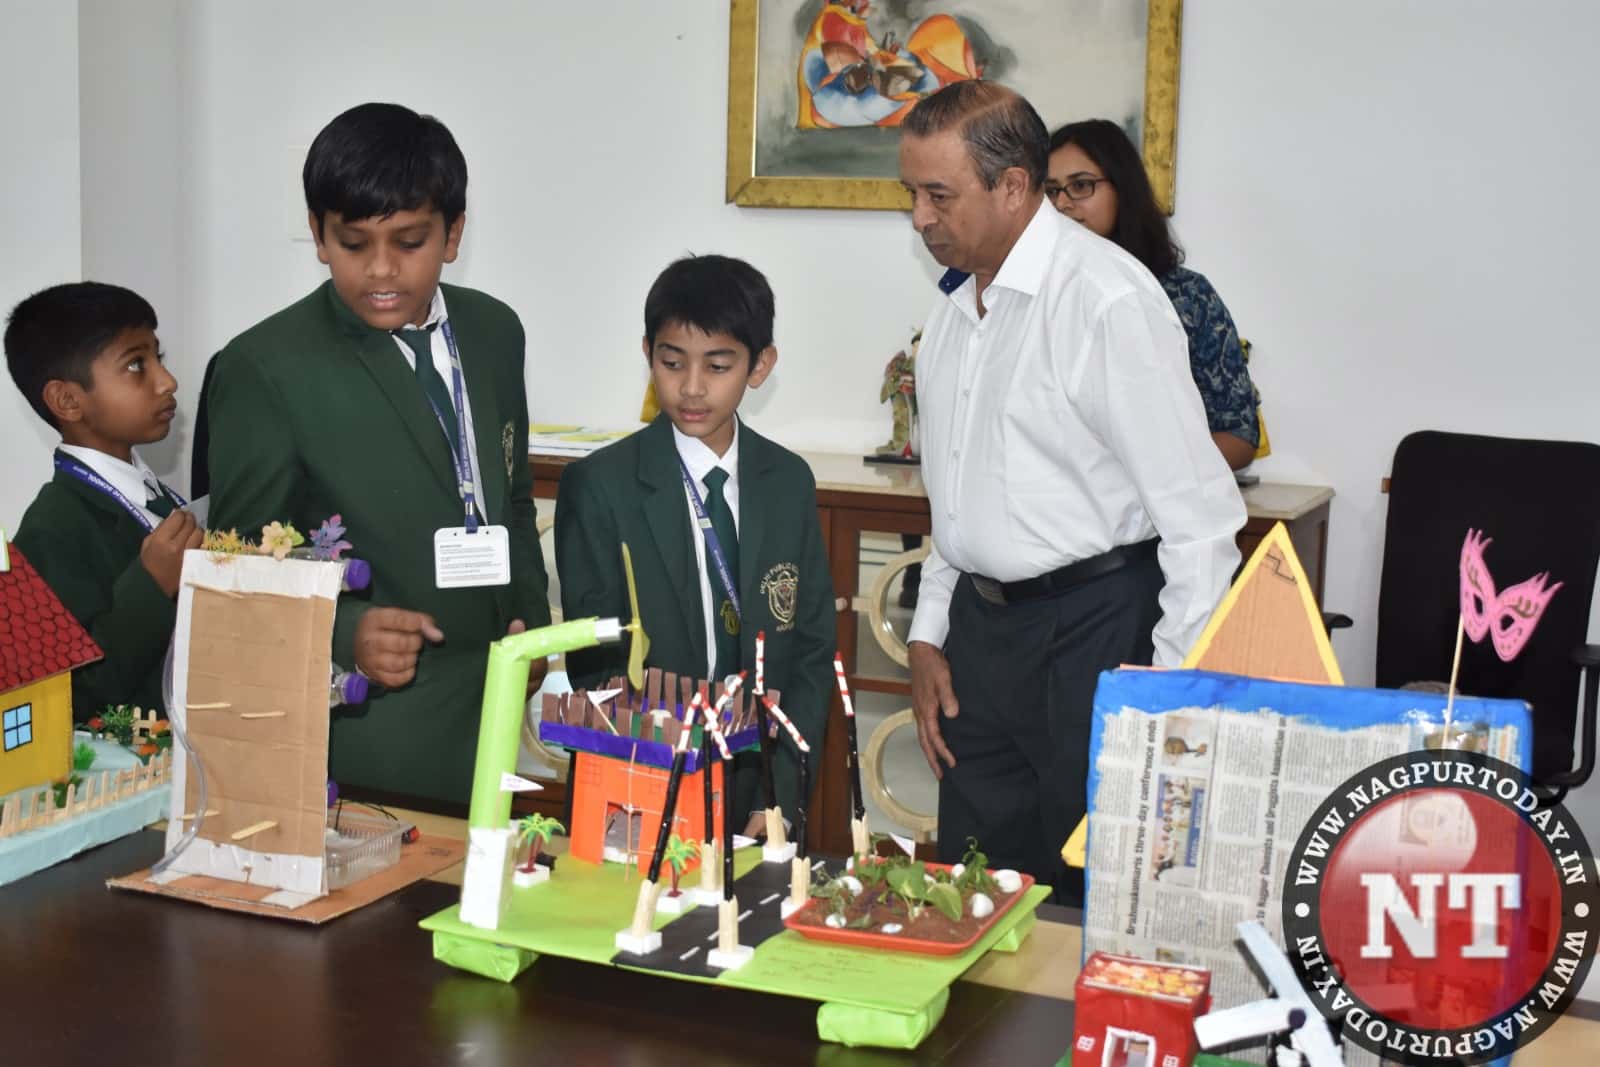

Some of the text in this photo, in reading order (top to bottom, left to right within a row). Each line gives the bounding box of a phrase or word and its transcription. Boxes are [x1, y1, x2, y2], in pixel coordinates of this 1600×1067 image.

[87, 473, 114, 493] SCHOOL
[1270, 730, 1285, 776] Association
[1265, 779, 1279, 817] Druggists
[1126, 720, 1157, 936] Brahmakumaris three-day conference ends
[1265, 820, 1275, 836] and
[1260, 838, 1273, 875] Chemists
[1257, 878, 1269, 907] Nagpur
